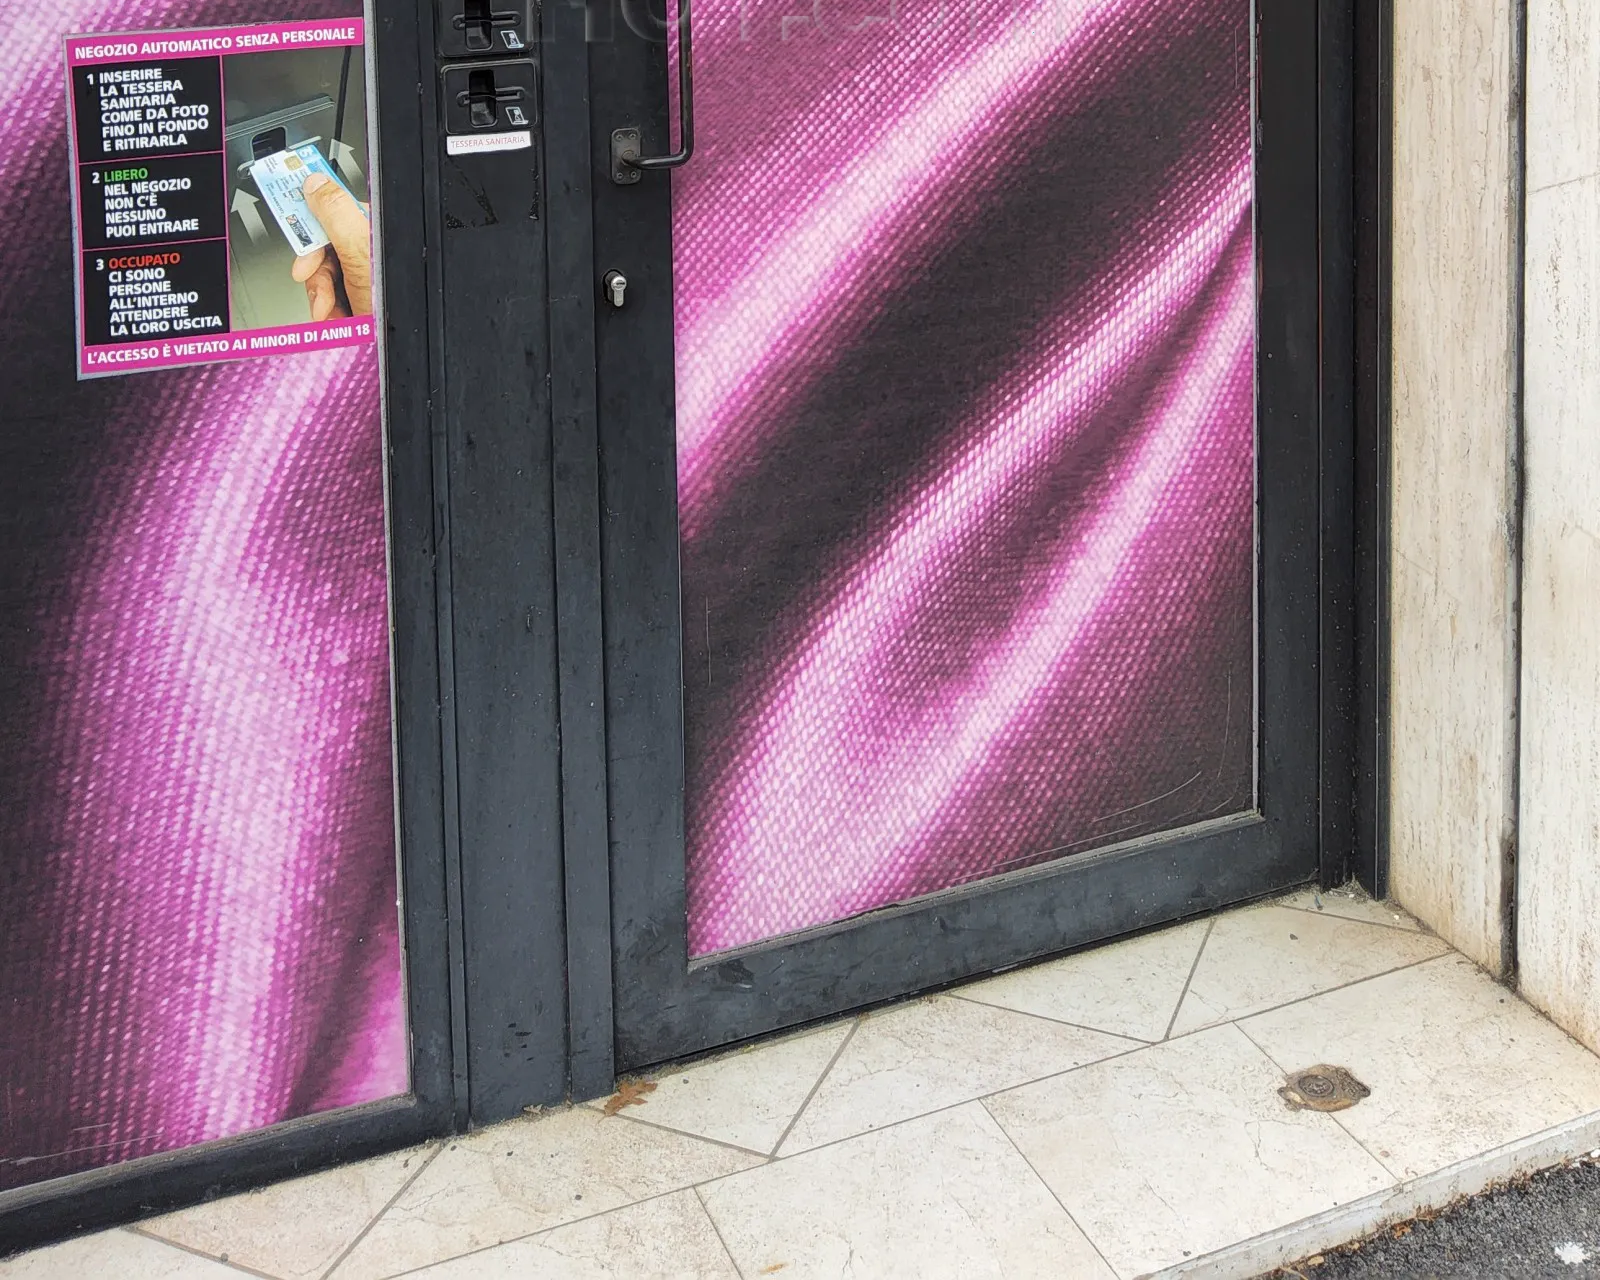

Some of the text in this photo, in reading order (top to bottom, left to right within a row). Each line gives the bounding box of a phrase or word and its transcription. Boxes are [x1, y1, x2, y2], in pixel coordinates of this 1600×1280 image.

[75, 28, 355, 59] NEGOZIO AUTOMATICO SENZA PERSONALE
[87, 68, 162, 85] 1 INSERIRE
[100, 80, 183, 97] LA TESSERA
[101, 94, 176, 111] SANITARIA
[101, 105, 209, 124] COME DA FOTO
[102, 118, 209, 138] FINO IN FONDO
[103, 133, 187, 152] E RITIRARLA
[451, 136, 525, 148] TESSERA SANITARIA
[92, 168, 148, 183] 2 LIBERO
[105, 178, 191, 196] NEL NEGOZIO
[105, 193, 157, 210] NON C'È
[106, 208, 166, 224] NESSUNO
[106, 219, 199, 238] PUOI ENTRARE
[96, 253, 180, 270] 3 OCCUPATO
[109, 268, 165, 282] CI SONO
[109, 281, 171, 296] PERSONE
[109, 291, 198, 310] ALL'INTERNO
[110, 306, 188, 323] ATTENDERE
[111, 316, 222, 336] LA LORO USCITA
[87, 324, 370, 364] L'ACCESSO È VIETATO AI MINORI DI ANNI 18
